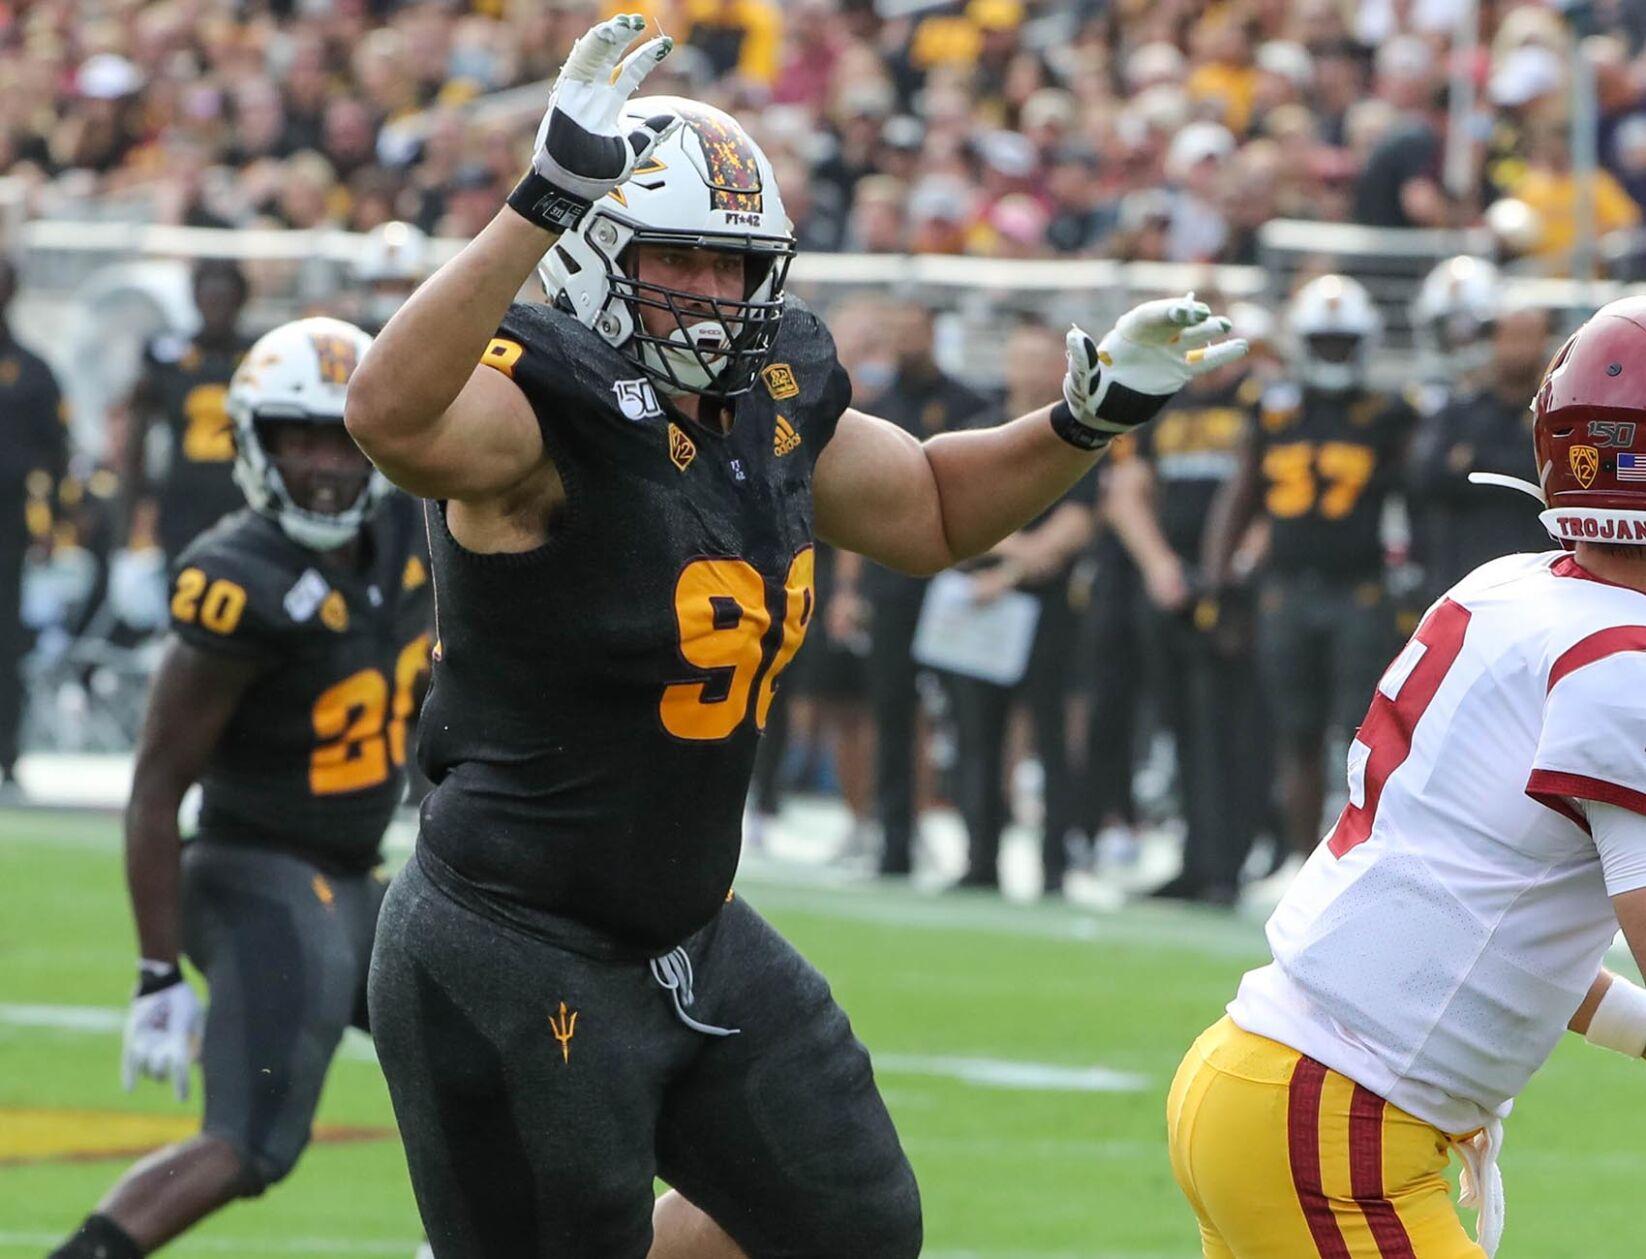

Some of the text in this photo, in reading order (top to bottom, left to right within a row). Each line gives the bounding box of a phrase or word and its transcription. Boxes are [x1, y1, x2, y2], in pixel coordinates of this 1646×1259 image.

[1587, 421, 1636, 448] 150
[1577, 464, 1591, 480] 12
[1557, 517, 1646, 540] TROJAN
[170, 567, 248, 635] 20
